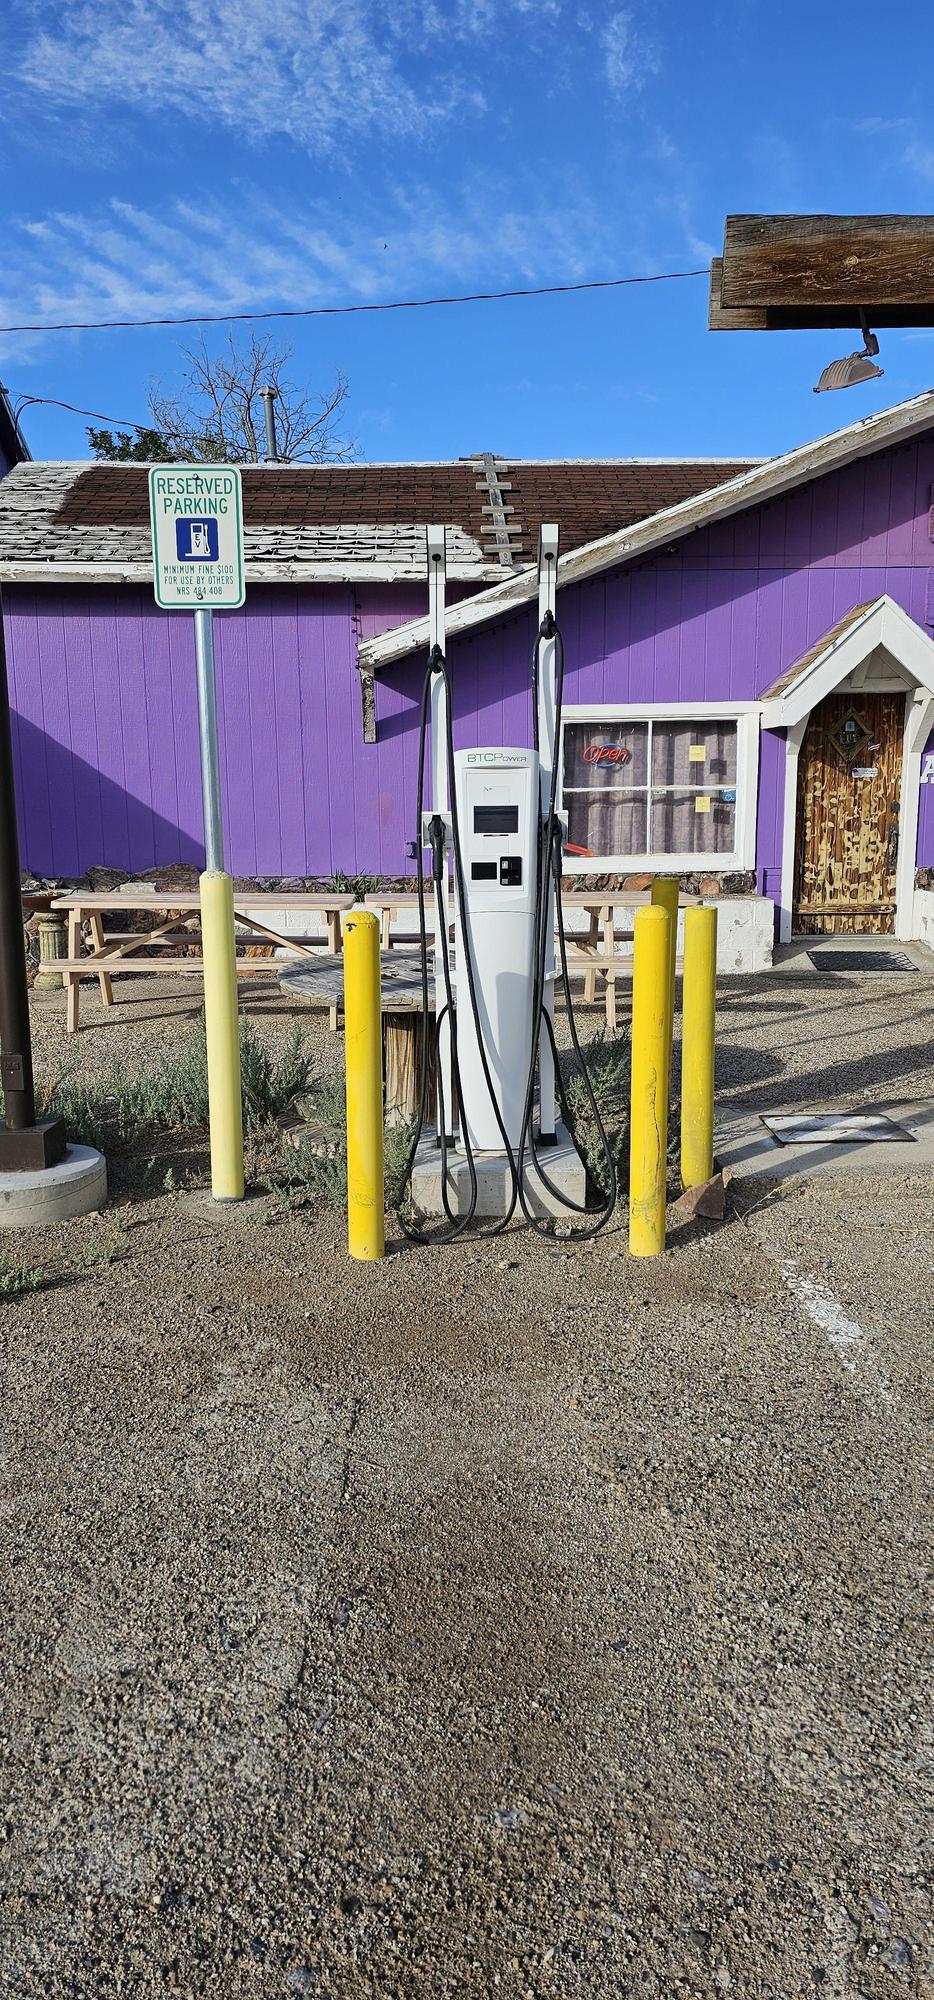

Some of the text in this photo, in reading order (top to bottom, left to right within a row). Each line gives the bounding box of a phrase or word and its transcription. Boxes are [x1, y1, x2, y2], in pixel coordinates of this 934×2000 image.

[157, 478, 233, 494] RESERVED
[164, 498, 228, 513] PARKING
[163, 564, 234, 574] MINIMUM FINE $100
[164, 575, 234, 585] FOR USE BY OTHERS
[176, 586, 190, 595] NRS
